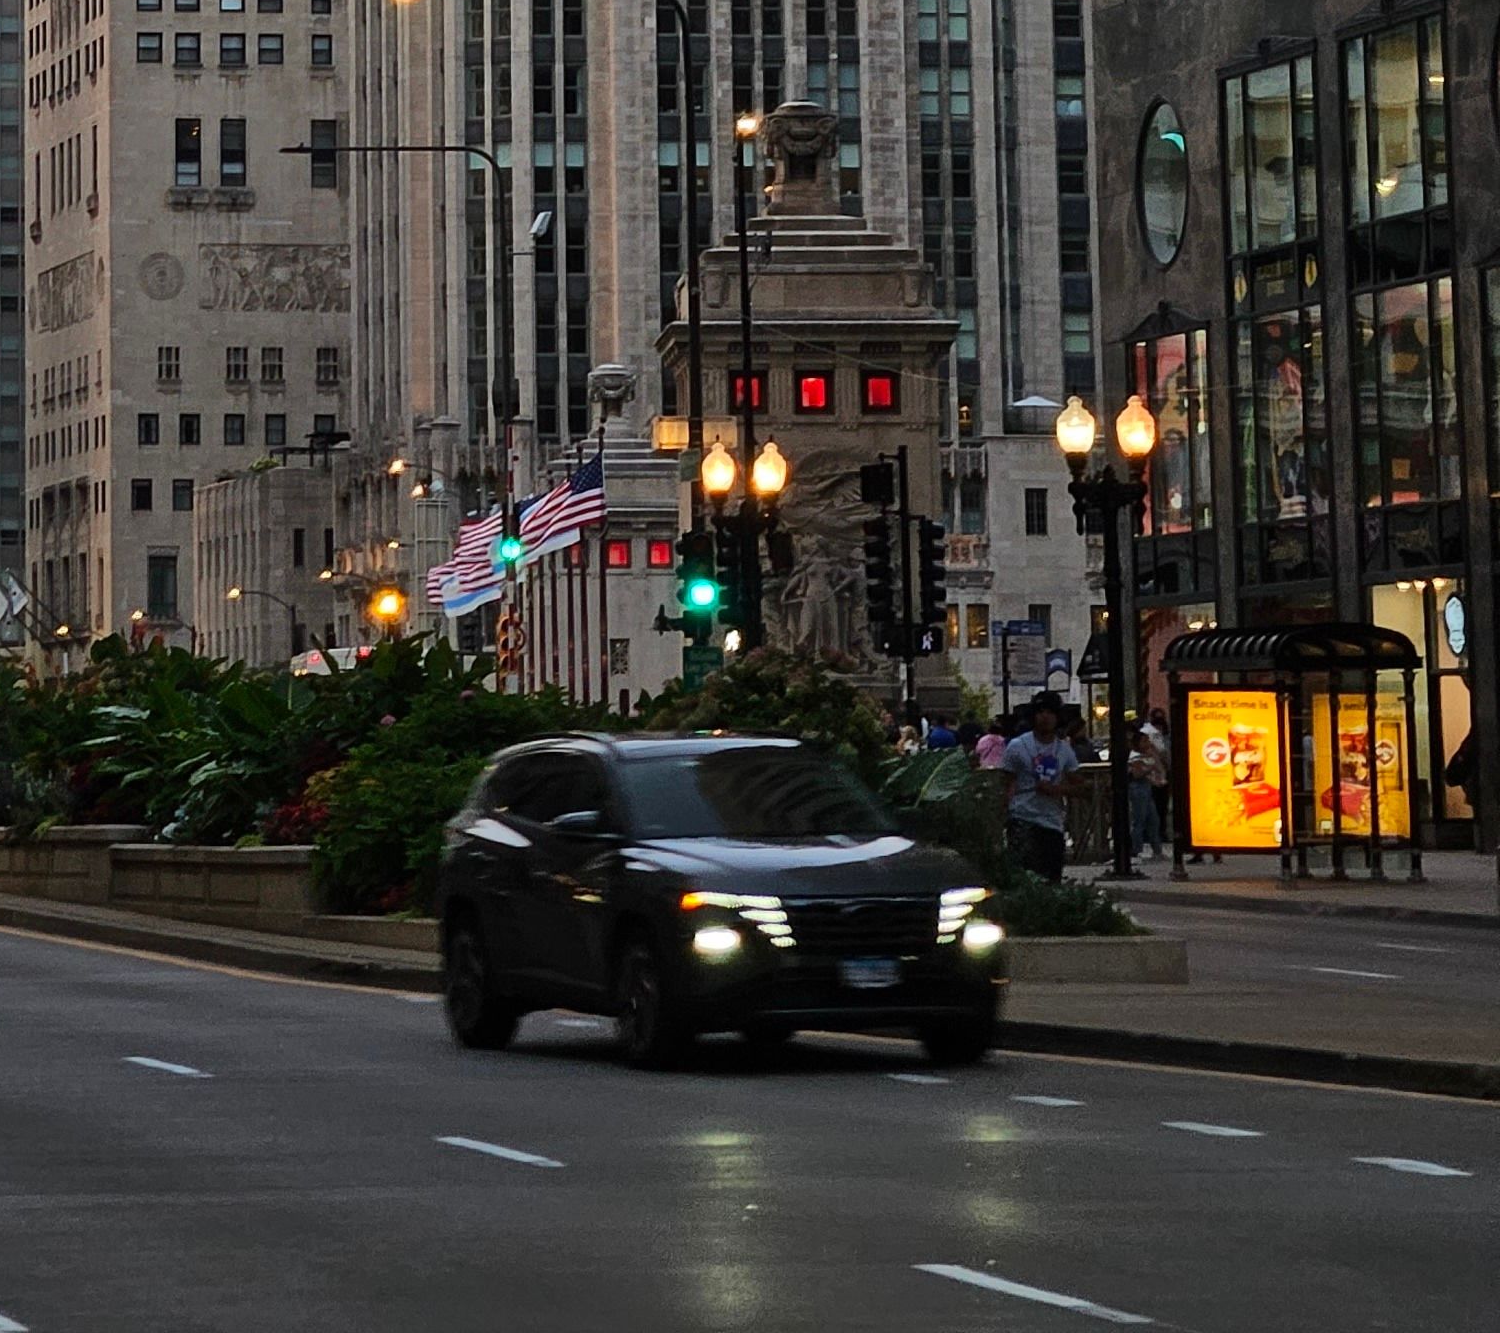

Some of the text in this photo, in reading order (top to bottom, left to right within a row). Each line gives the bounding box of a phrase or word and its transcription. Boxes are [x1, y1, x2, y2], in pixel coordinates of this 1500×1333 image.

[1193, 699, 1269, 709] Snack time is
[1194, 711, 1232, 723] calling
